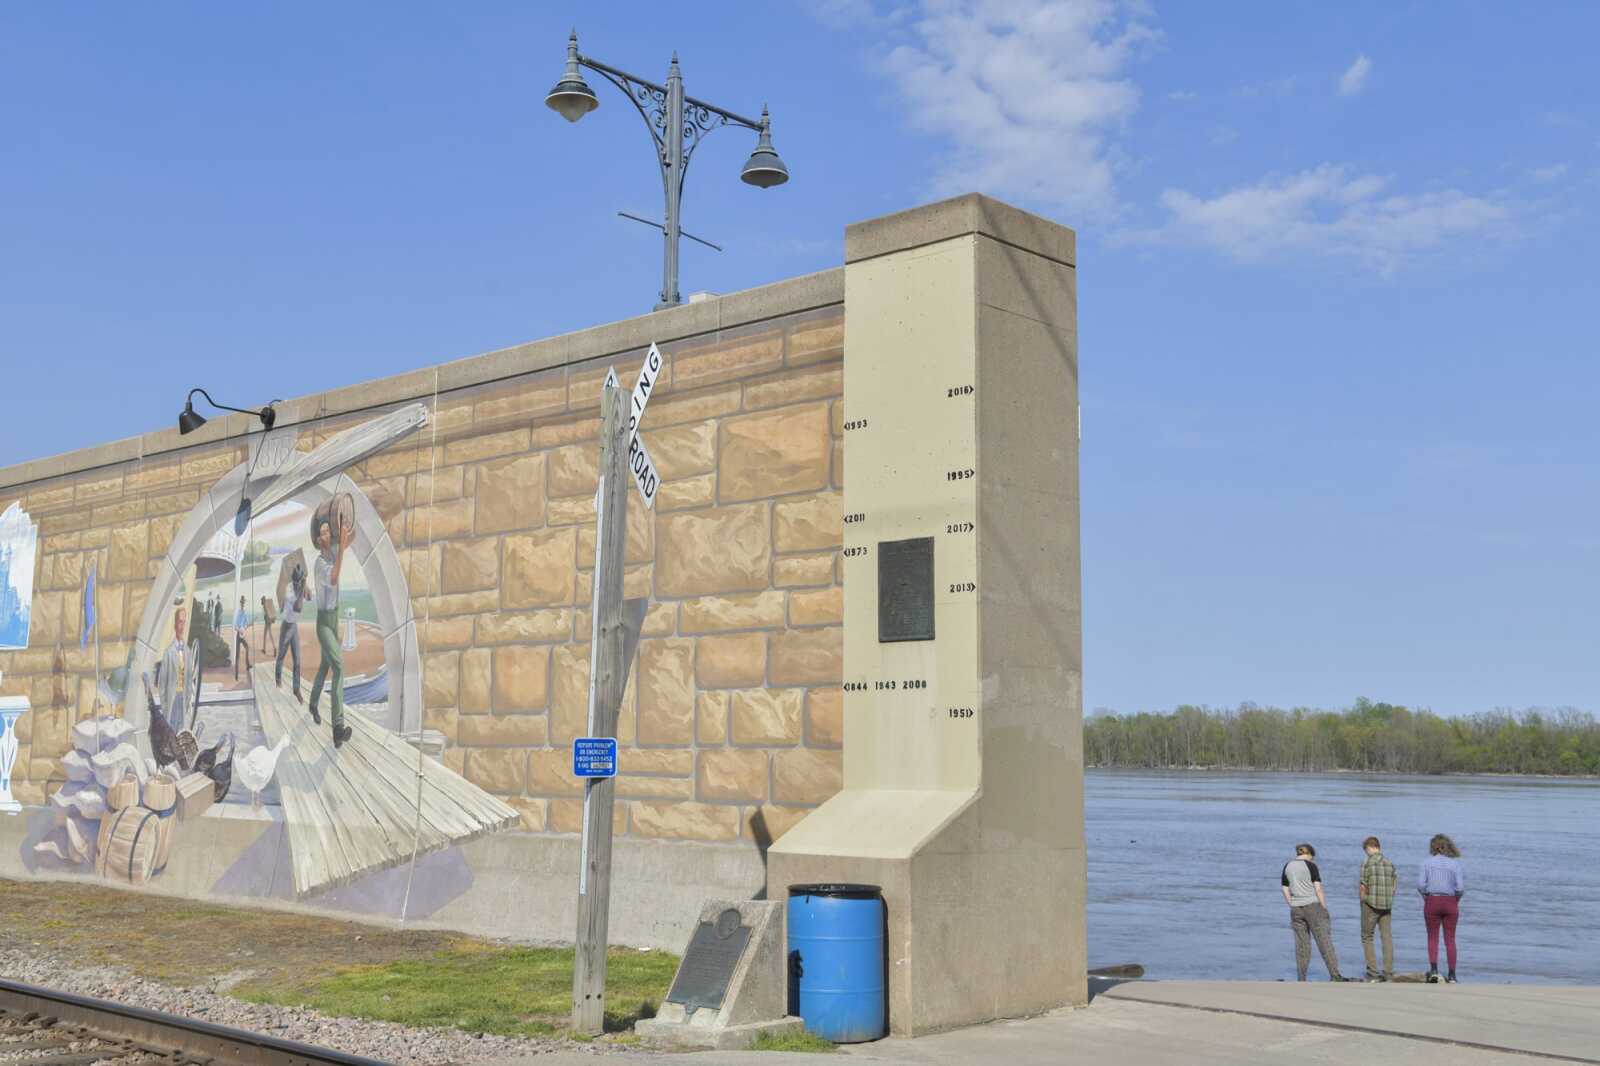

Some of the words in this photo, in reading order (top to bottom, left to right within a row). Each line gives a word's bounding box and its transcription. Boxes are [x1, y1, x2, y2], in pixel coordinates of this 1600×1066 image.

[947, 385, 969, 398] 2016
[847, 419, 868, 431] 1993
[629, 438, 656, 499] ROAD
[947, 470, 970, 481] 1995
[848, 513, 865, 523] 2011
[947, 523, 969, 534] 2017
[847, 547, 868, 557] 1973
[950, 583, 971, 593] 2013
[875, 680, 896, 690] 1943
[949, 708, 969, 718] 1951
